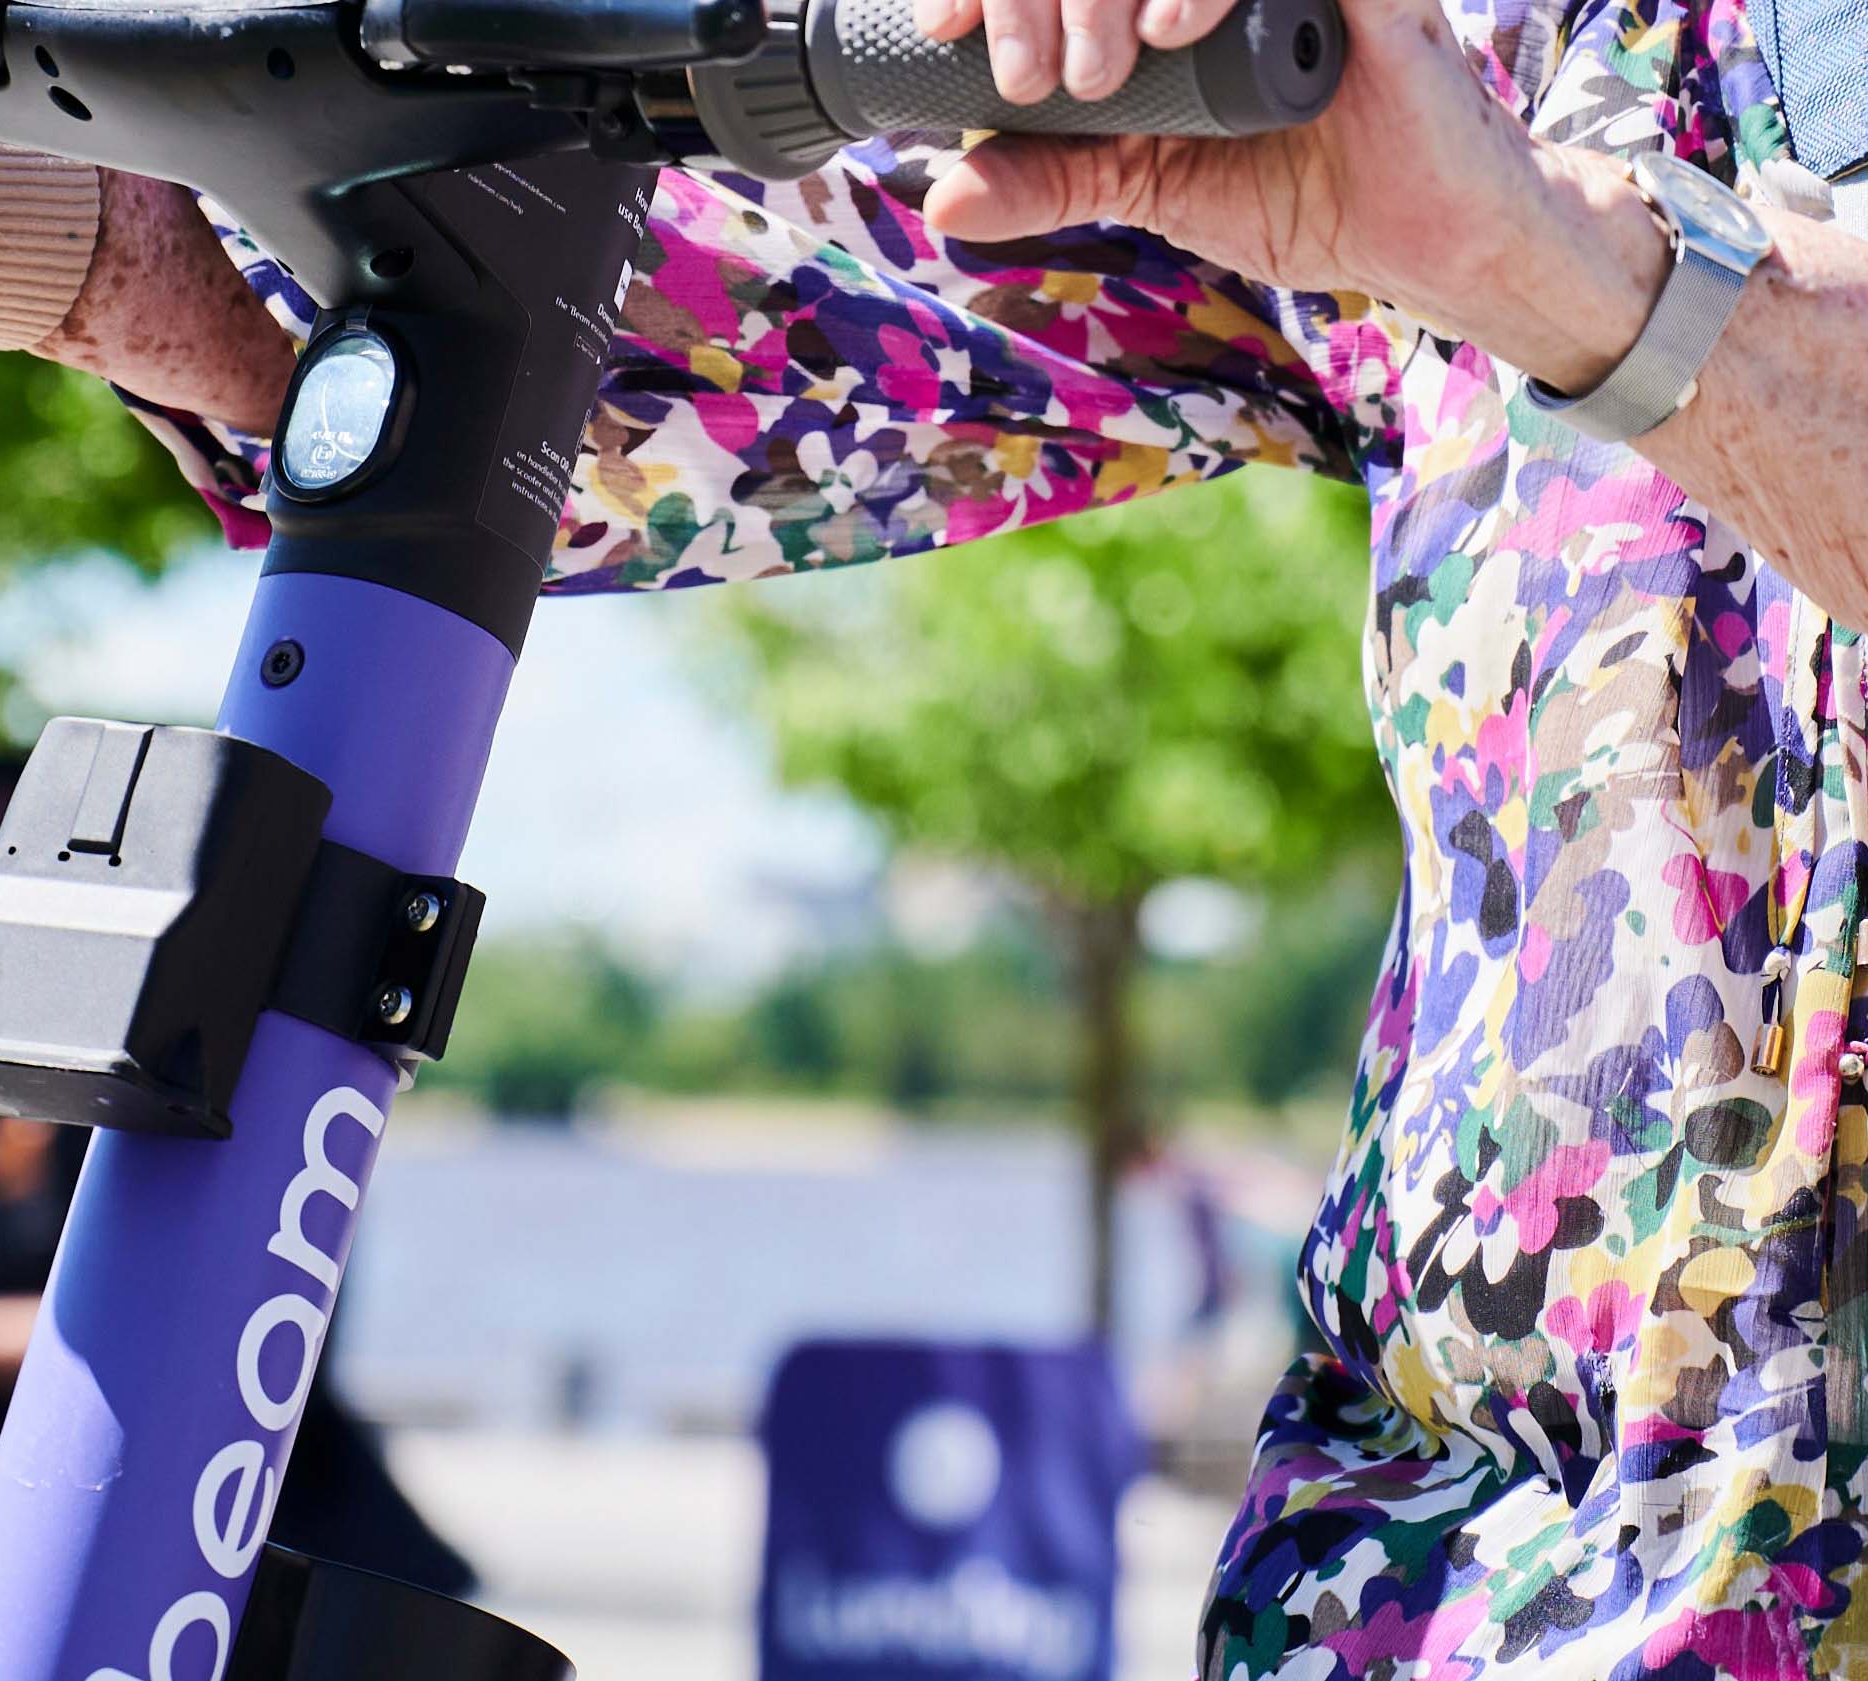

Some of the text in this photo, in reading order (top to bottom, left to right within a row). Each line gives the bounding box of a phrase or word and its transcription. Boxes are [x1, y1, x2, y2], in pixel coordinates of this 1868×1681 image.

[617, 202, 633, 223] use
[555, 296, 568, 311] the
[516, 450, 527, 462] on
[540, 440, 561, 464] Scan
[502, 456, 516, 471] the
[516, 467, 542, 488] scooter
